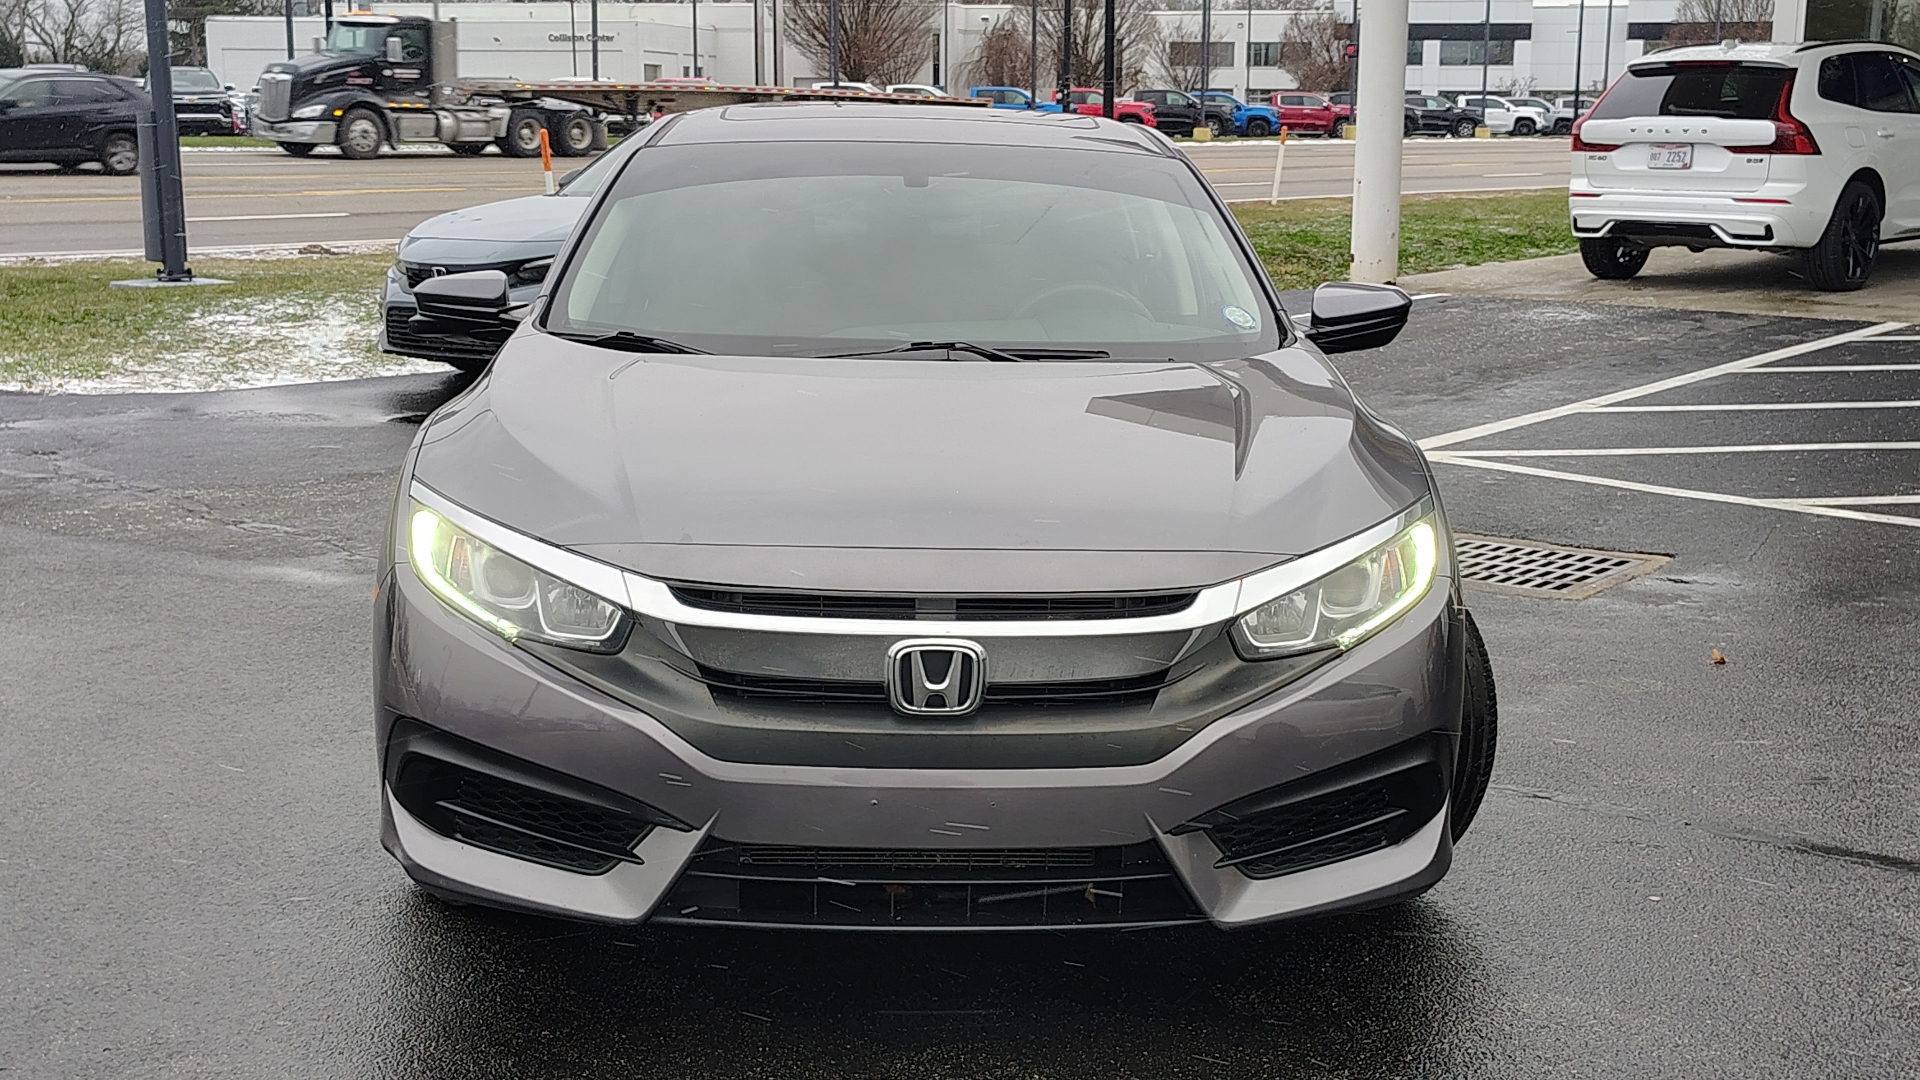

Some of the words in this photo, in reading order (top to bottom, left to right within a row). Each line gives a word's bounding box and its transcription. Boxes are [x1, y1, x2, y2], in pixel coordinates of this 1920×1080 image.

[548, 33, 585, 42] Collison
[586, 33, 615, 42] Cnter
[1666, 151, 1688, 163] 2252
